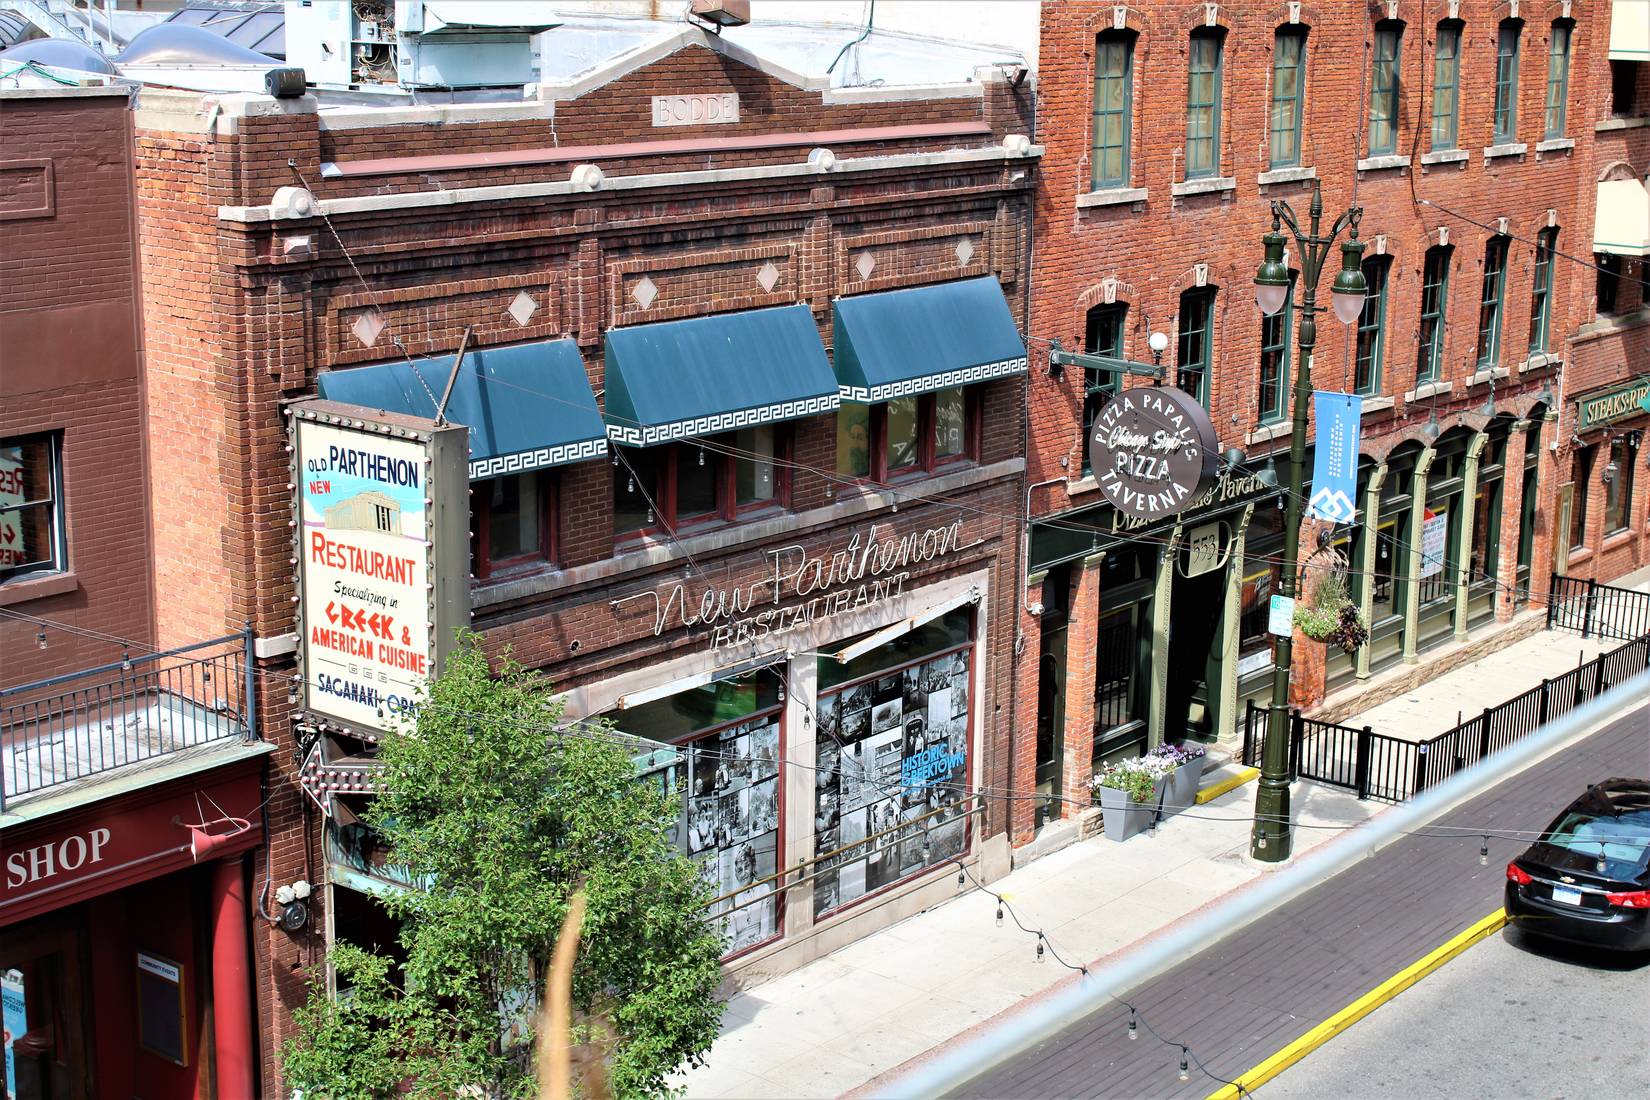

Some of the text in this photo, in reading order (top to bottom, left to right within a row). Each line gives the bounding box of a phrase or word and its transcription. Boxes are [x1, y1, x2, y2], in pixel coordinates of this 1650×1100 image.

[659, 96, 734, 121] BODDE
[1095, 397, 1134, 444] PIZZA
[1107, 425, 1149, 453] Chicago
[308, 445, 418, 488] OLD PARTHENON
[309, 480, 331, 495] NEW
[1101, 469, 1189, 512] TAVERNA
[312, 531, 416, 587] RESTAURANT
[1193, 535, 1216, 564] 553
[334, 580, 398, 609] Specializing in
[609, 523, 984, 635] New Parthenon
[325, 601, 411, 647] GREEK &
[710, 571, 910, 652] RESTAURANT
[312, 626, 426, 675] AMERICAN CUISINE
[318, 673, 378, 708] SAGANAKI
[901, 752, 965, 787] GREEKTOWN
[902, 743, 948, 772] HISTORIC
[7, 828, 110, 889] SHOP
